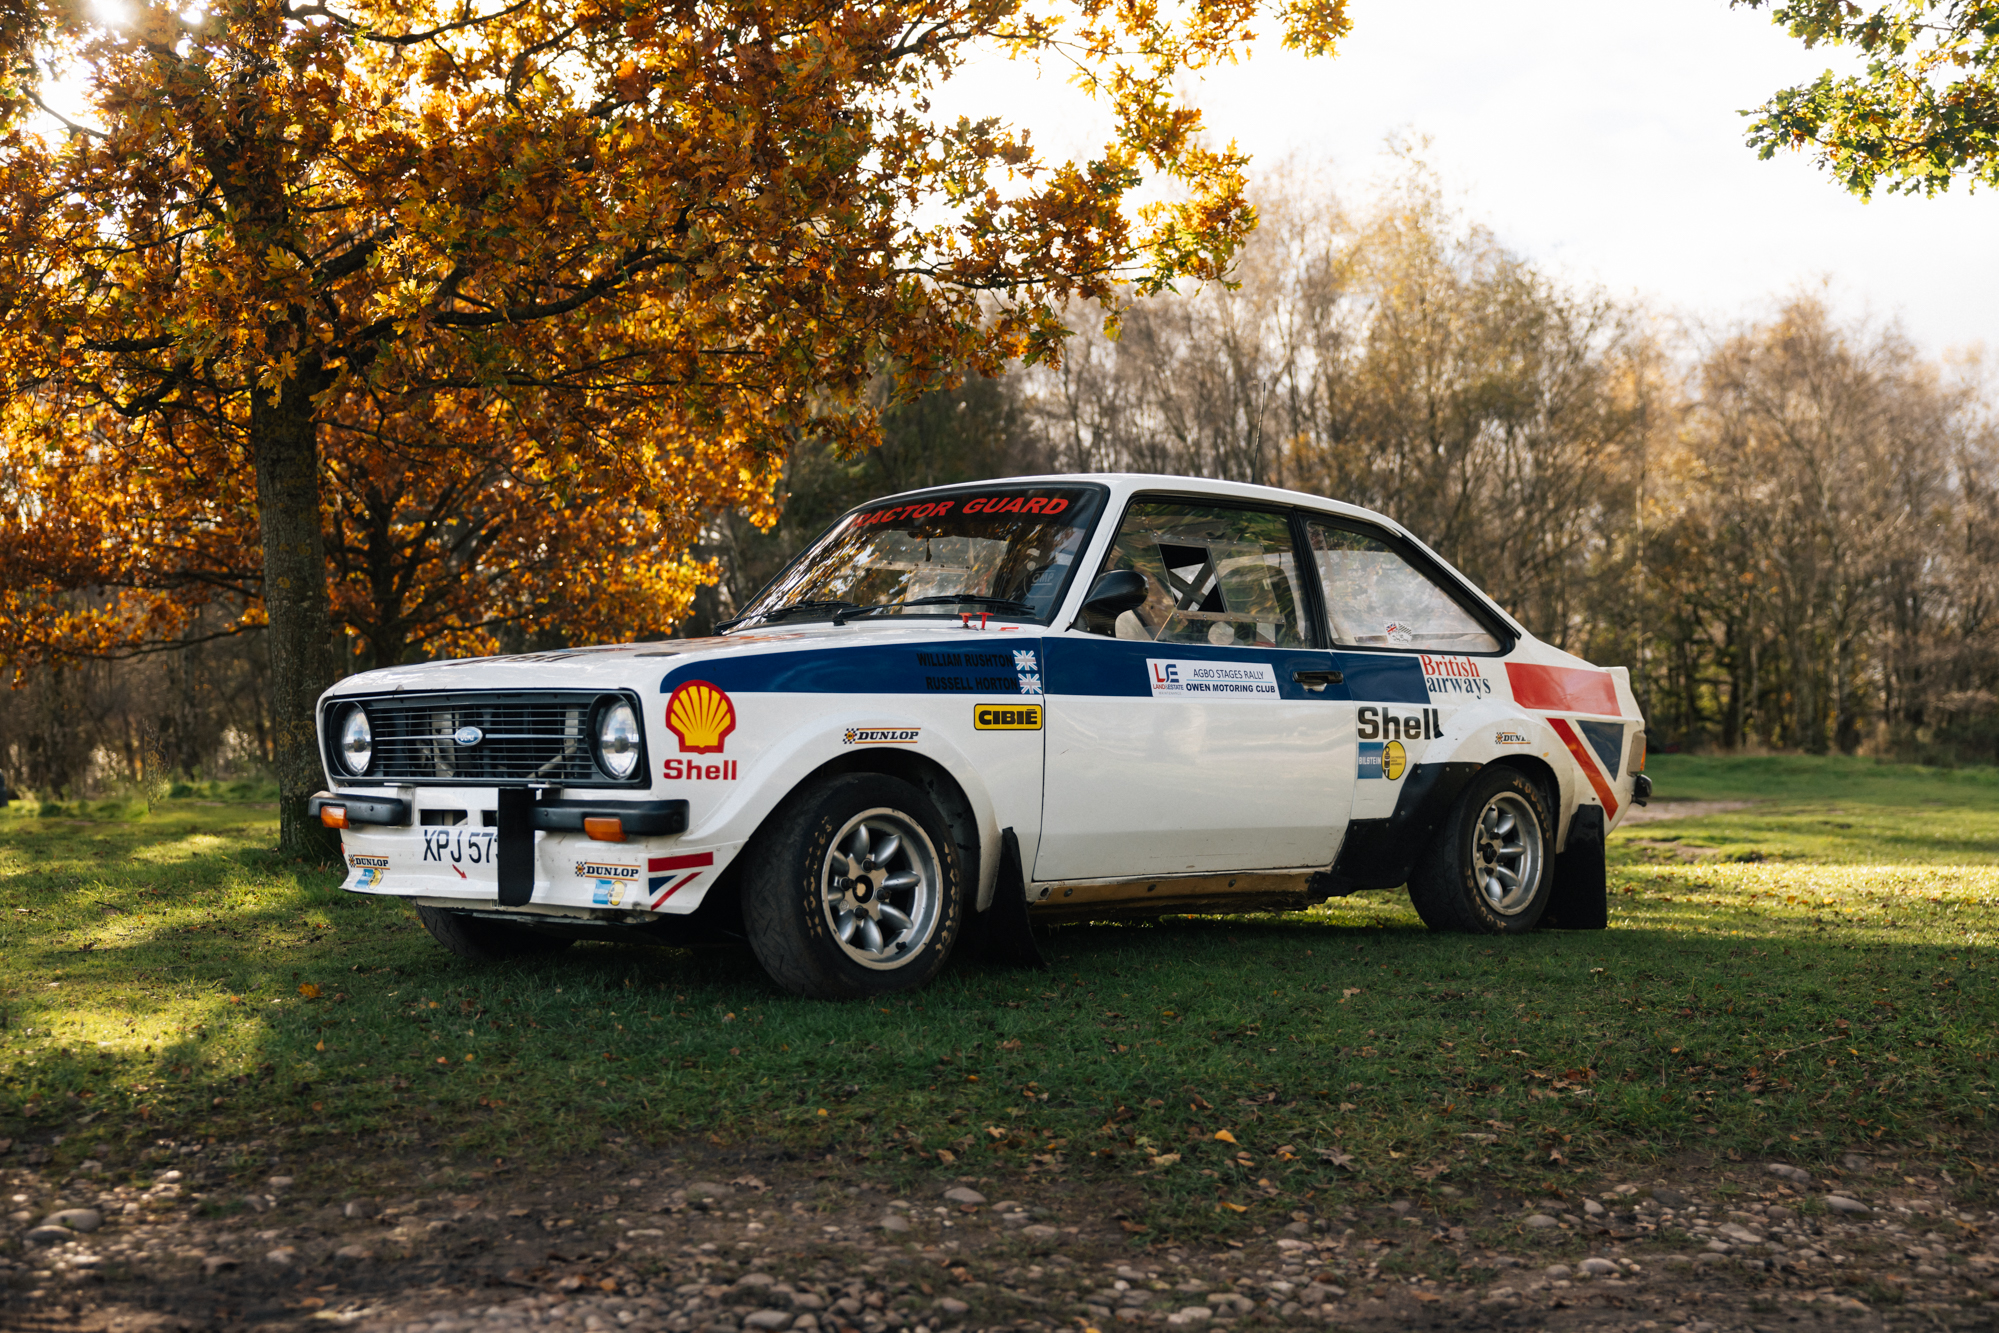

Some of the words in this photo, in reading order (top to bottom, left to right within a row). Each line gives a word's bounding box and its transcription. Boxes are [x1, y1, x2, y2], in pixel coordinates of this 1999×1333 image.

[846, 501, 955, 531] RACTOR
[962, 497, 1069, 515] GUARD
[916, 653, 962, 667] WILLIAM
[965, 654, 1014, 668] RUSHTON
[1419, 655, 1480, 678] British
[1193, 669, 1215, 678] AGBO
[1216, 669, 1243, 679] STAGES
[1244, 671, 1264, 680] RALLY
[925, 677, 973, 691] RUSSELL
[975, 677, 1018, 691] HORTON
[1186, 683, 1211, 692] OWEN
[1212, 684, 1253, 693] MOTORING
[1256, 685, 1276, 693] CLUB
[1428, 676, 1491, 699] airways
[1357, 707, 1444, 740] Shell
[857, 731, 919, 740] DUNLOP
[1358, 756, 1382, 765] BILSTEIN
[664, 759, 738, 780] Shell
[423, 829, 463, 863] XPJ
[469, 831, 498, 864] 57
[355, 857, 389, 867] DUNLOP
[586, 865, 639, 878] DUNLOP
